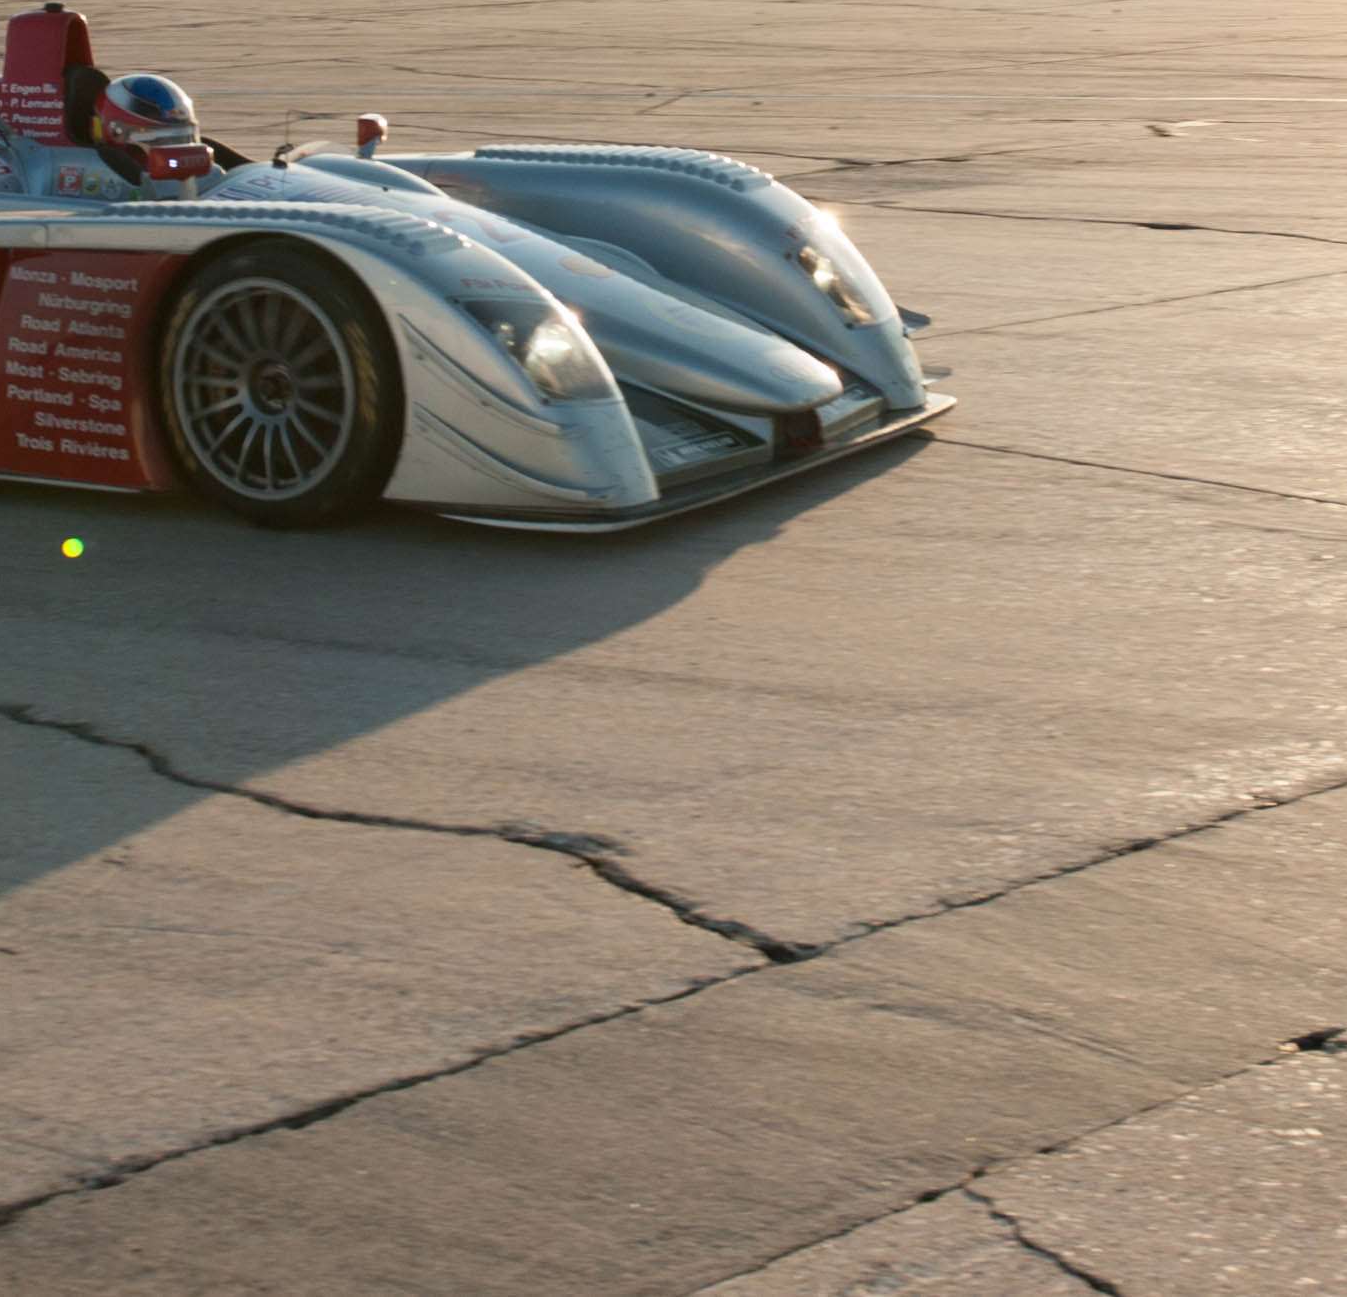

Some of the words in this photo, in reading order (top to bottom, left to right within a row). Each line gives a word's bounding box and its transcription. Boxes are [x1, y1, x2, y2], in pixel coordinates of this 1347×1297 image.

[10, 265, 58, 285] Monza
[70, 270, 139, 293] Mosport
[19, 313, 61, 333] Road
[68, 319, 126, 340] Atlanta
[7, 335, 49, 356] Road
[54, 341, 123, 364] America
[5, 358, 45, 379] Most
[57, 366, 123, 391] Sebring
[6, 383, 74, 408] Portland
[87, 393, 123, 413] Spa
[33, 410, 126, 437] Silverstone
[14, 431, 55, 453] Trois
